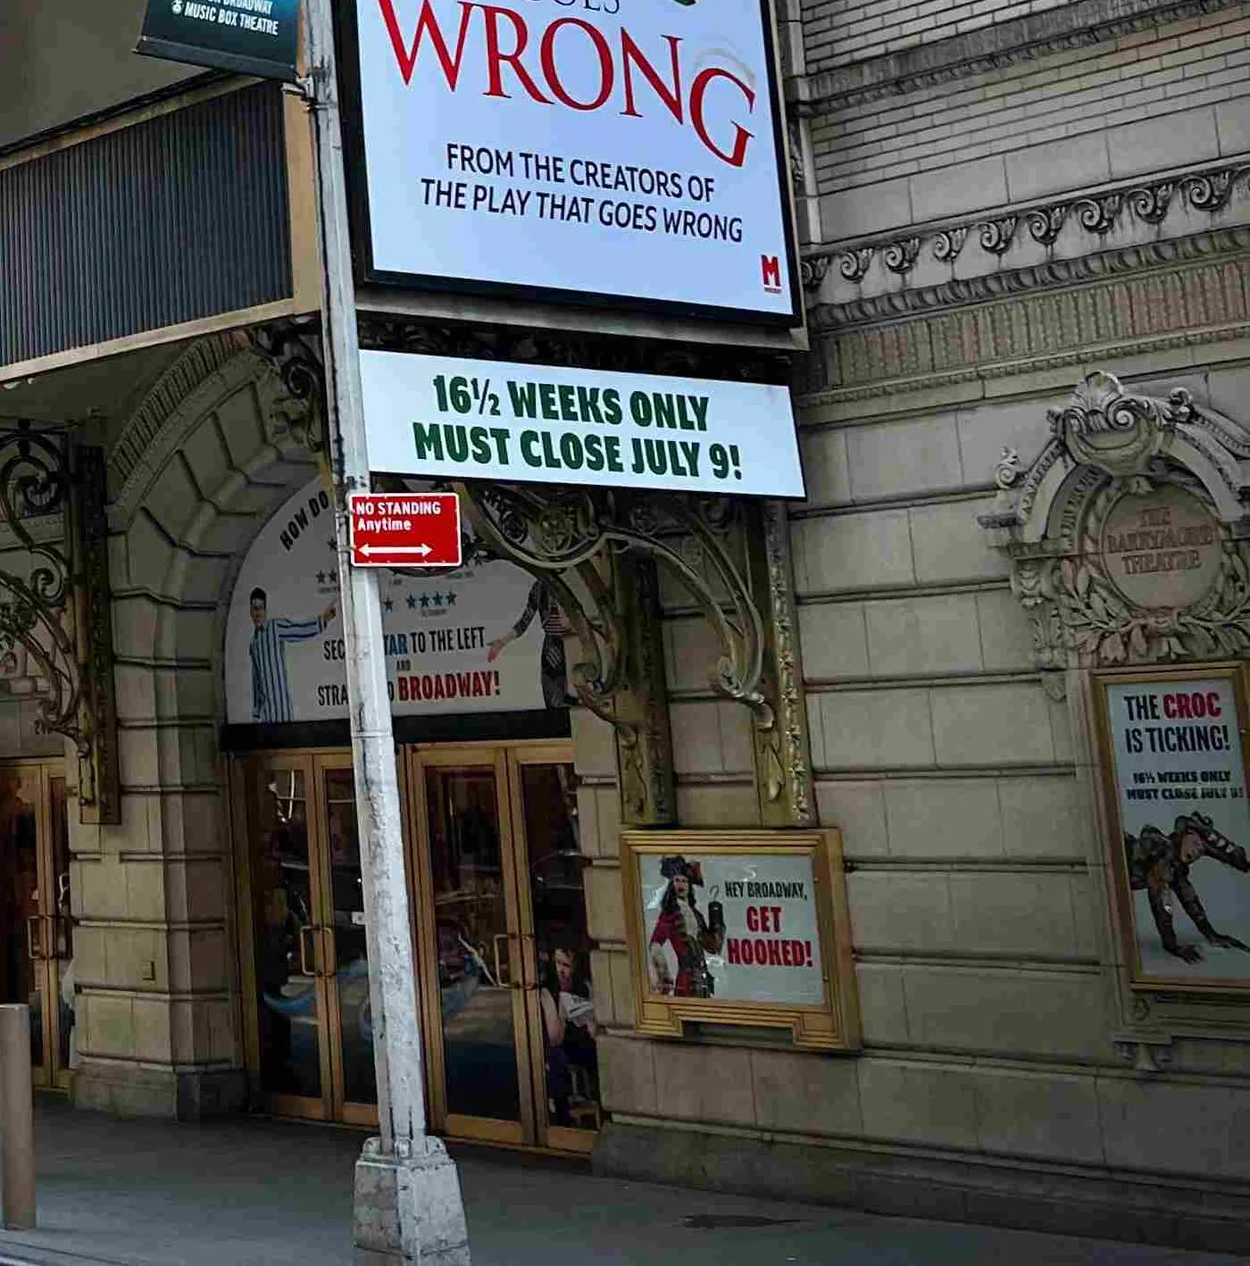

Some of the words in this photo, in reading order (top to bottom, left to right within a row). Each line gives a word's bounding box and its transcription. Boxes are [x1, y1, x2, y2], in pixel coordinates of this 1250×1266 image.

[184, 1, 216, 22] MUSIC
[218, 9, 238, 27] BOX
[239, 13, 279, 36] THEATRE
[447, 143, 514, 177] FROM
[520, 152, 565, 183] THE
[569, 159, 683, 199] CREATORS
[688, 176, 715, 202] OF
[421, 178, 468, 211] THE
[474, 186, 532, 217] PLAY
[536, 192, 595, 224] THAT
[599, 201, 657, 232] GOES
[662, 208, 743, 243] WRONG
[507, 380, 623, 427] WEEKS
[630, 390, 710, 432] ONLY
[412, 422, 511, 465] MUST
[520, 429, 623, 474] CLOSE
[631, 438, 700, 477] JULY
[710, 443, 743, 480] 9!
[280, 507, 309, 551] HOW
[308, 490, 329, 518] DO
[356, 501, 375, 515] NO
[377, 501, 441, 515] STANDING
[357, 517, 412, 532] Anytime
[410, 632, 426, 654] TO
[429, 629, 454, 652] THE
[457, 626, 485, 650] LEFT
[396, 659, 412, 672] AND
[398, 671, 500, 701] BROADWAY!
[1124, 695, 1160, 721] THE
[1163, 692, 1221, 719] CROC
[1125, 728, 1143, 753] IS
[1145, 725, 1230, 752] TICKING!
[1157, 770, 1198, 783] WEEKS
[1200, 770, 1231, 782] ONLY
[1126, 788, 1159, 801] MUST
[1161, 787, 1198, 800] CLOSE
[725, 881, 744, 898] HEY
[747, 882, 808, 901] BROADWAY,
[746, 906, 782, 933] GET
[727, 938, 813, 968] HOOKED!
